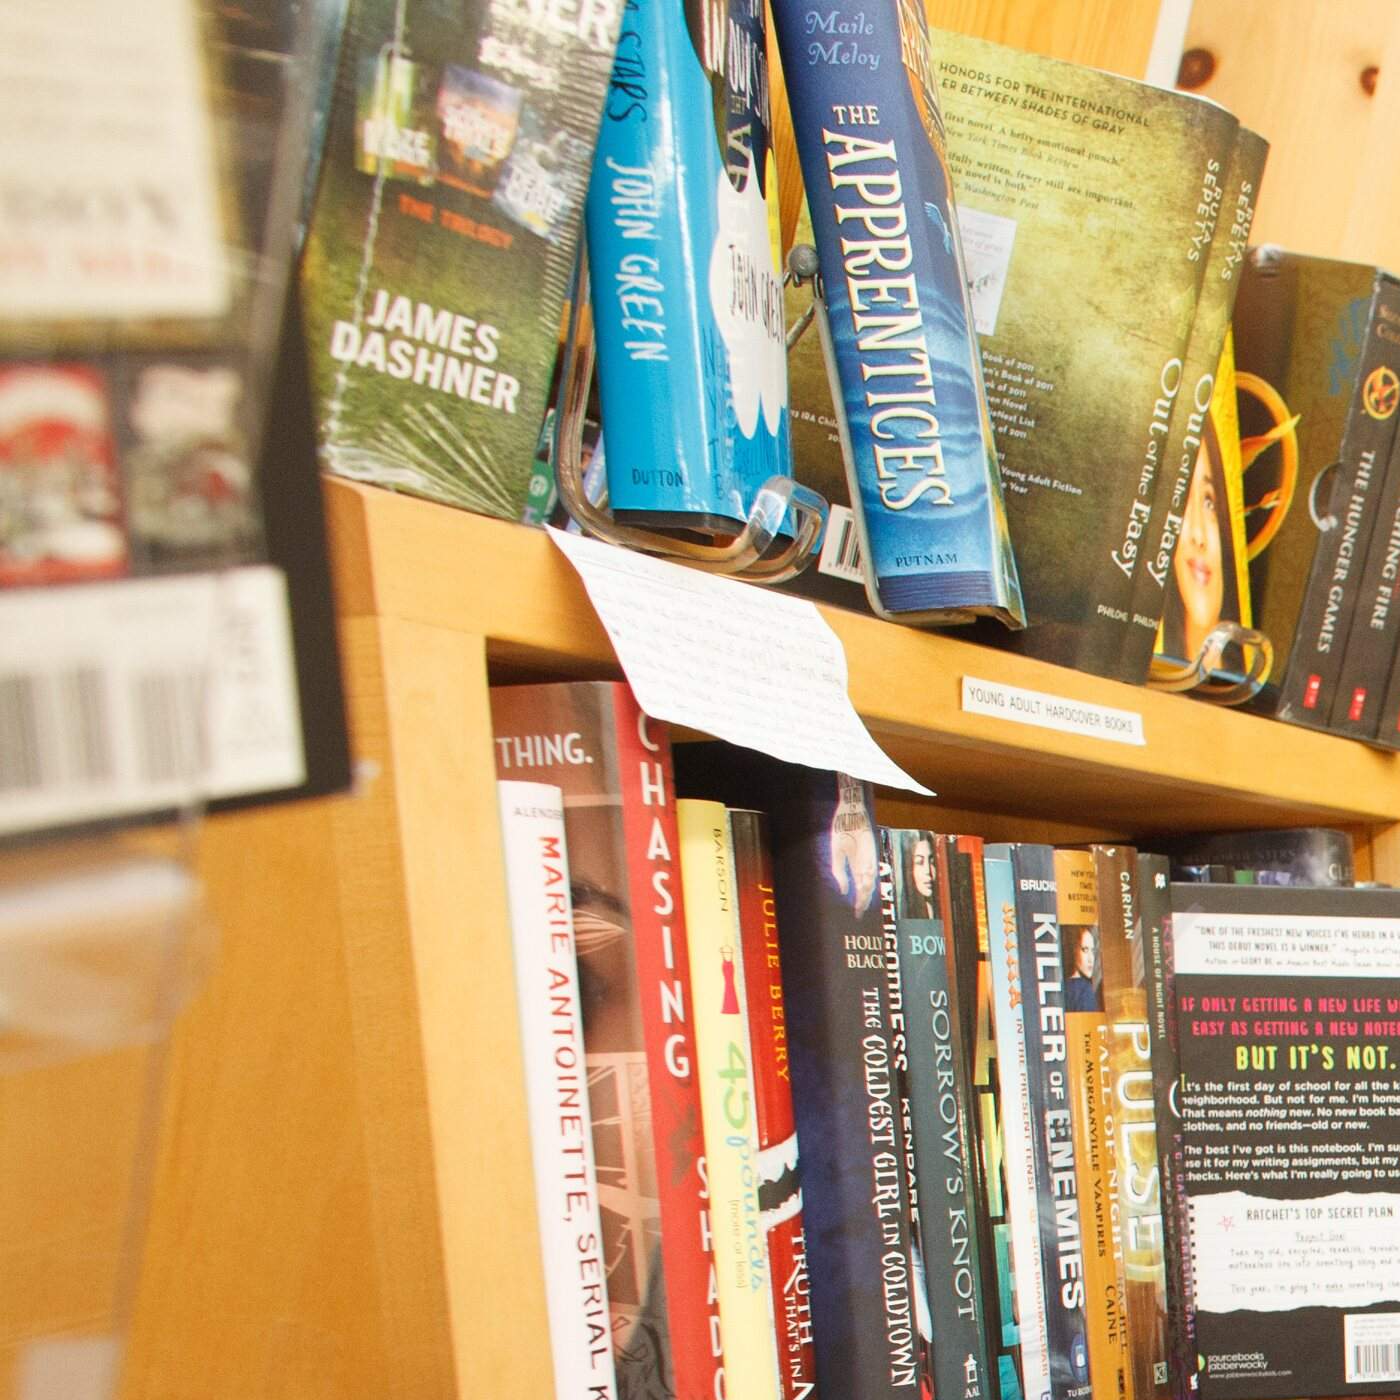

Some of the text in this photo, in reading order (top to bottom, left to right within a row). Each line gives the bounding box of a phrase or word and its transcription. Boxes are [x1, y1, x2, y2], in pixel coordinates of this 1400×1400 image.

[805, 10, 876, 37] Maile
[807, 41, 881, 70] Meloy
[833, 103, 881, 126] THE
[939, 62, 1152, 128] HONORS FOR THE INTERNATIONAL
[960, 81, 1018, 108] BETWEEN
[1021, 99, 1069, 121] SHADES
[1071, 113, 1089, 125] OF
[1091, 118, 1126, 137] GRAY
[1187, 159, 1219, 262] SEPETYS
[1202, 187, 1222, 244] RUTA
[606, 157, 670, 362] JOHN GREEN
[366, 290, 501, 364] JAMES
[823, 127, 955, 512] APPRENTICES
[331, 321, 521, 415] DASHNER
[632, 467, 684, 488] DUTTON
[895, 552, 958, 568] PUTNAM
[1111, 499, 1152, 580] Easy
[1316, 450, 1377, 656] THE HUNGER GAMES
[1369, 586, 1393, 632] FIRE
[968, 686, 1134, 734] YOUNG ADULT HARDCOVER BOOKS
[498, 732, 593, 769] THING.
[538, 834, 574, 956] MARIE
[637, 712, 690, 1079] CHASING
[711, 826, 729, 914] BARSON
[1119, 870, 1134, 940] CARMAN
[844, 935, 884, 951] HOLLY
[846, 953, 886, 970] BLACK
[1153, 935, 1162, 966] HOUSE
[758, 883, 790, 1083] JULIE BERRY
[1157, 980, 1165, 1010] NIGHT
[1182, 997, 1196, 1012] IF
[1202, 998, 1236, 1012] ONLY
[1242, 998, 1298, 1012] GETTING
[1303, 998, 1313, 1012] A
[1318, 998, 1348, 1012] NEW
[1353, 998, 1382, 1013] LIFE
[1158, 1012, 1167, 1040] NOVEL
[1192, 1021, 1225, 1036] EASY
[1231, 1021, 1248, 1035] AS
[1254, 1021, 1309, 1035] GETTING
[1314, 1021, 1324, 1035] A
[1330, 1021, 1358, 1035] NEW
[1204, 1081, 1224, 1092] the
[1227, 1081, 1251, 1092] first
[1254, 1081, 1275, 1095] day
[1278, 1081, 1291, 1092] of
[1294, 1080, 1331, 1091] school
[1334, 1080, 1351, 1091] for
[1354, 1080, 1368, 1091] all
[1371, 1080, 1390, 1091] the
[1235, 1044, 1397, 1071] BUT IT'S NOT.
[547, 967, 591, 1224] ANTOINETTE,
[717, 1040, 747, 1137] 45
[1032, 912, 1085, 1311] KILLER OF ENEMIES
[900, 1097, 920, 1223] KENDARE
[929, 990, 978, 1322] SORROW'S KNOT
[1083, 1032, 1107, 1258] THE MORGANVILLE VAMPIRES
[1113, 1021, 1163, 1252] PULSE
[861, 986, 917, 1388] THE COLDEST GIRL IN COLDTOWN
[1246, 1206, 1394, 1222] RATCHET'S TOP SECRET PLAN
[577, 1231, 615, 1369] SERIAL
[784, 1291, 804, 1356] THAT'S
[1105, 1284, 1118, 1345] CAINE
[790, 1357, 804, 1378] IN
[1207, 1352, 1265, 1364] sourcebooks
[1207, 1360, 1268, 1373] jabberwocky
